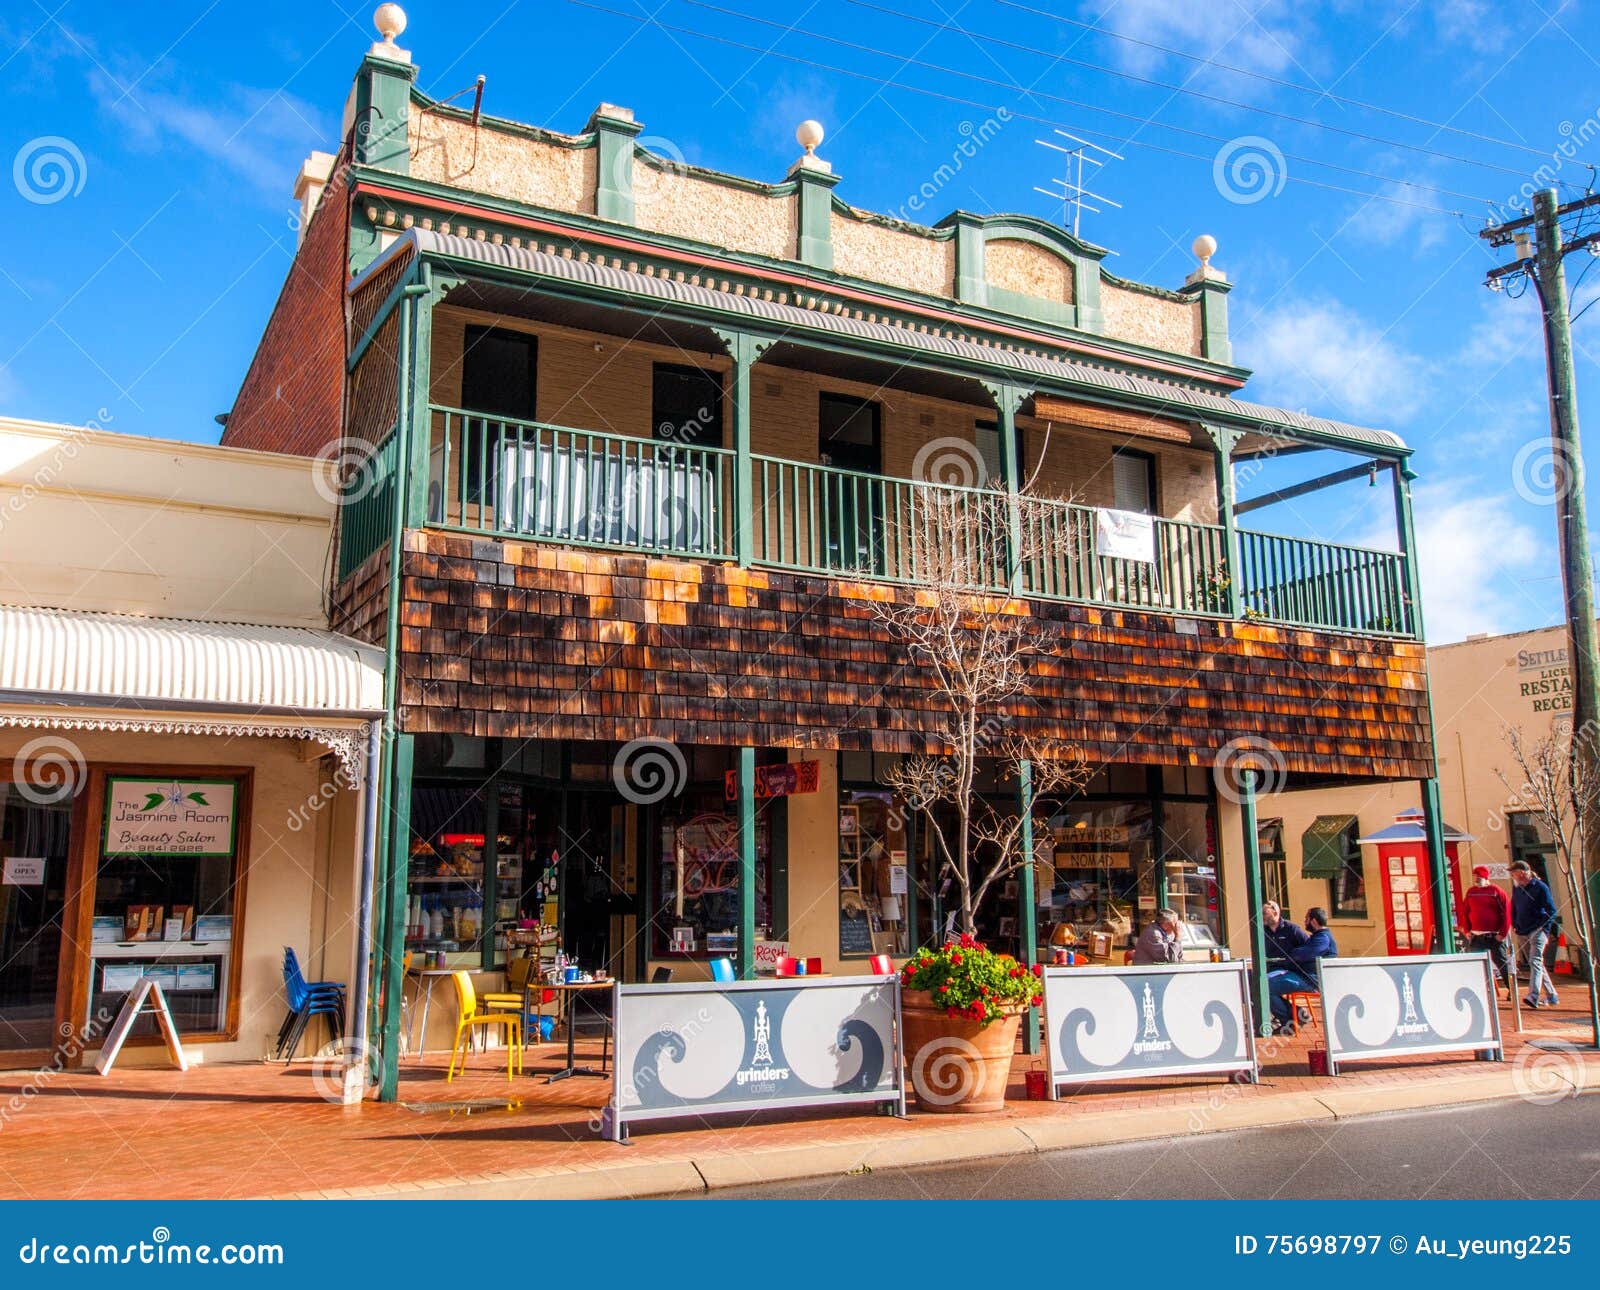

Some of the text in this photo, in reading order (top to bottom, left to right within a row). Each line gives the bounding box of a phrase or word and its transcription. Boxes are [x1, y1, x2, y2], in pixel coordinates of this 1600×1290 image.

[118, 801, 139, 809] The
[115, 810, 230, 823] Jasmine Room
[120, 831, 216, 844] Beauty Salon
[1062, 829, 1121, 841] WAYWARD
[1070, 854, 1114, 867] NOMAD
[1396, 1022, 1429, 1036] grinders
[1133, 1039, 1171, 1055] grinders
[736, 1067, 789, 1085] grinders
